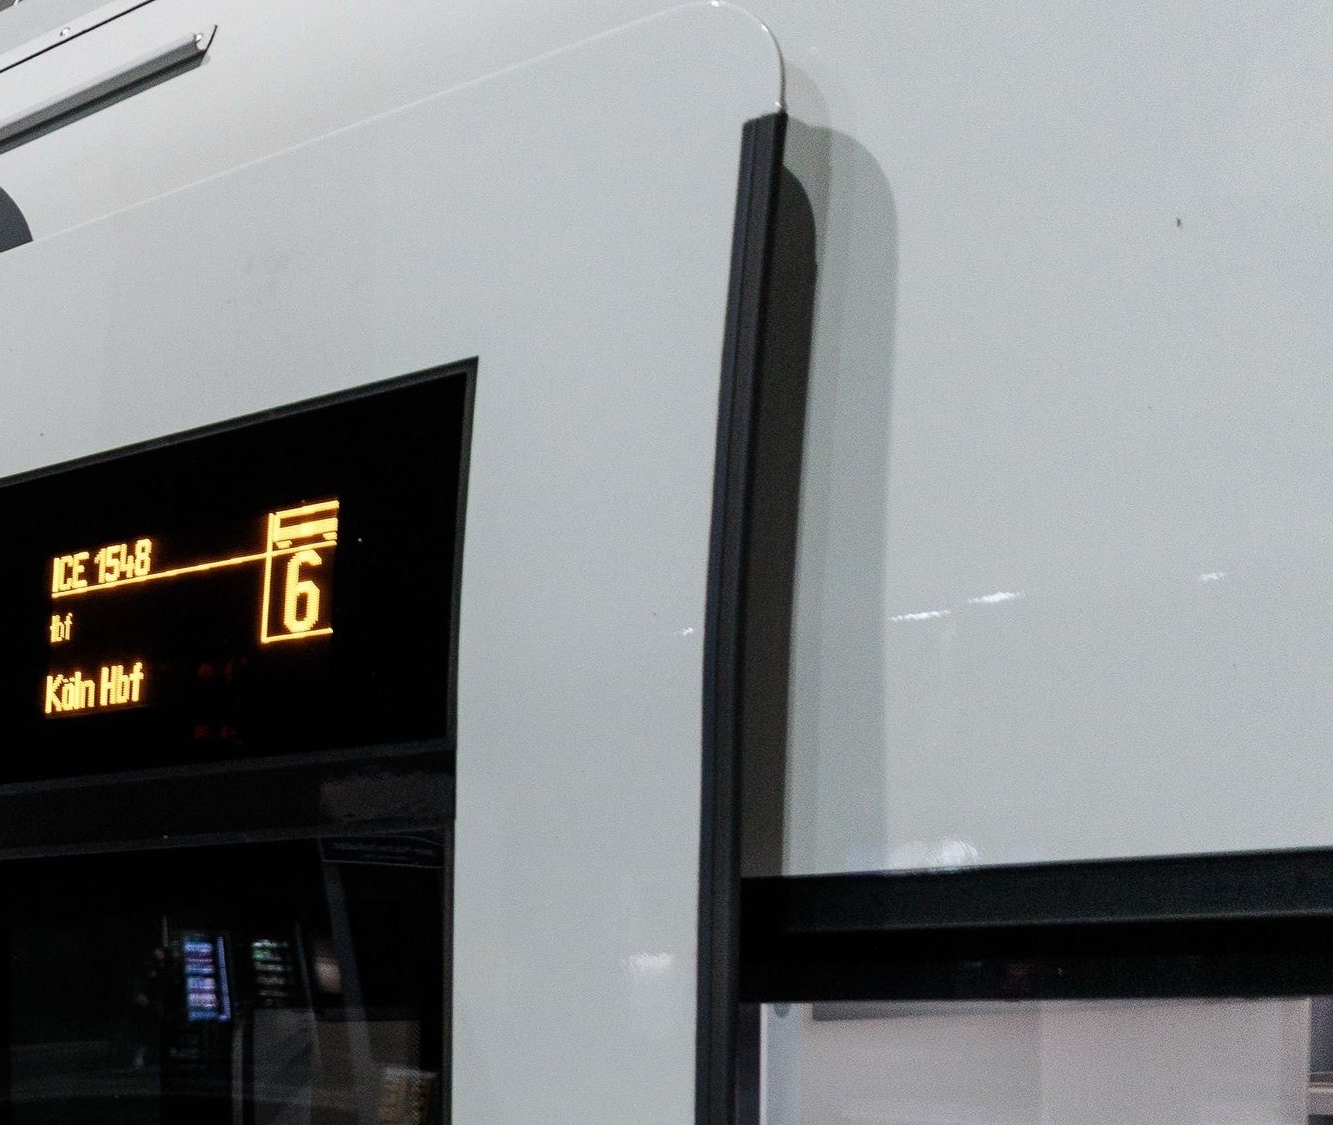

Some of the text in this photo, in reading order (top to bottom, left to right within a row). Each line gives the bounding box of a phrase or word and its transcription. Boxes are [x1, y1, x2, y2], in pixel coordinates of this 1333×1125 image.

[52, 538, 152, 593] ICE 1548
[284, 550, 323, 633] 6
[45, 661, 144, 714] Köln Hbf
